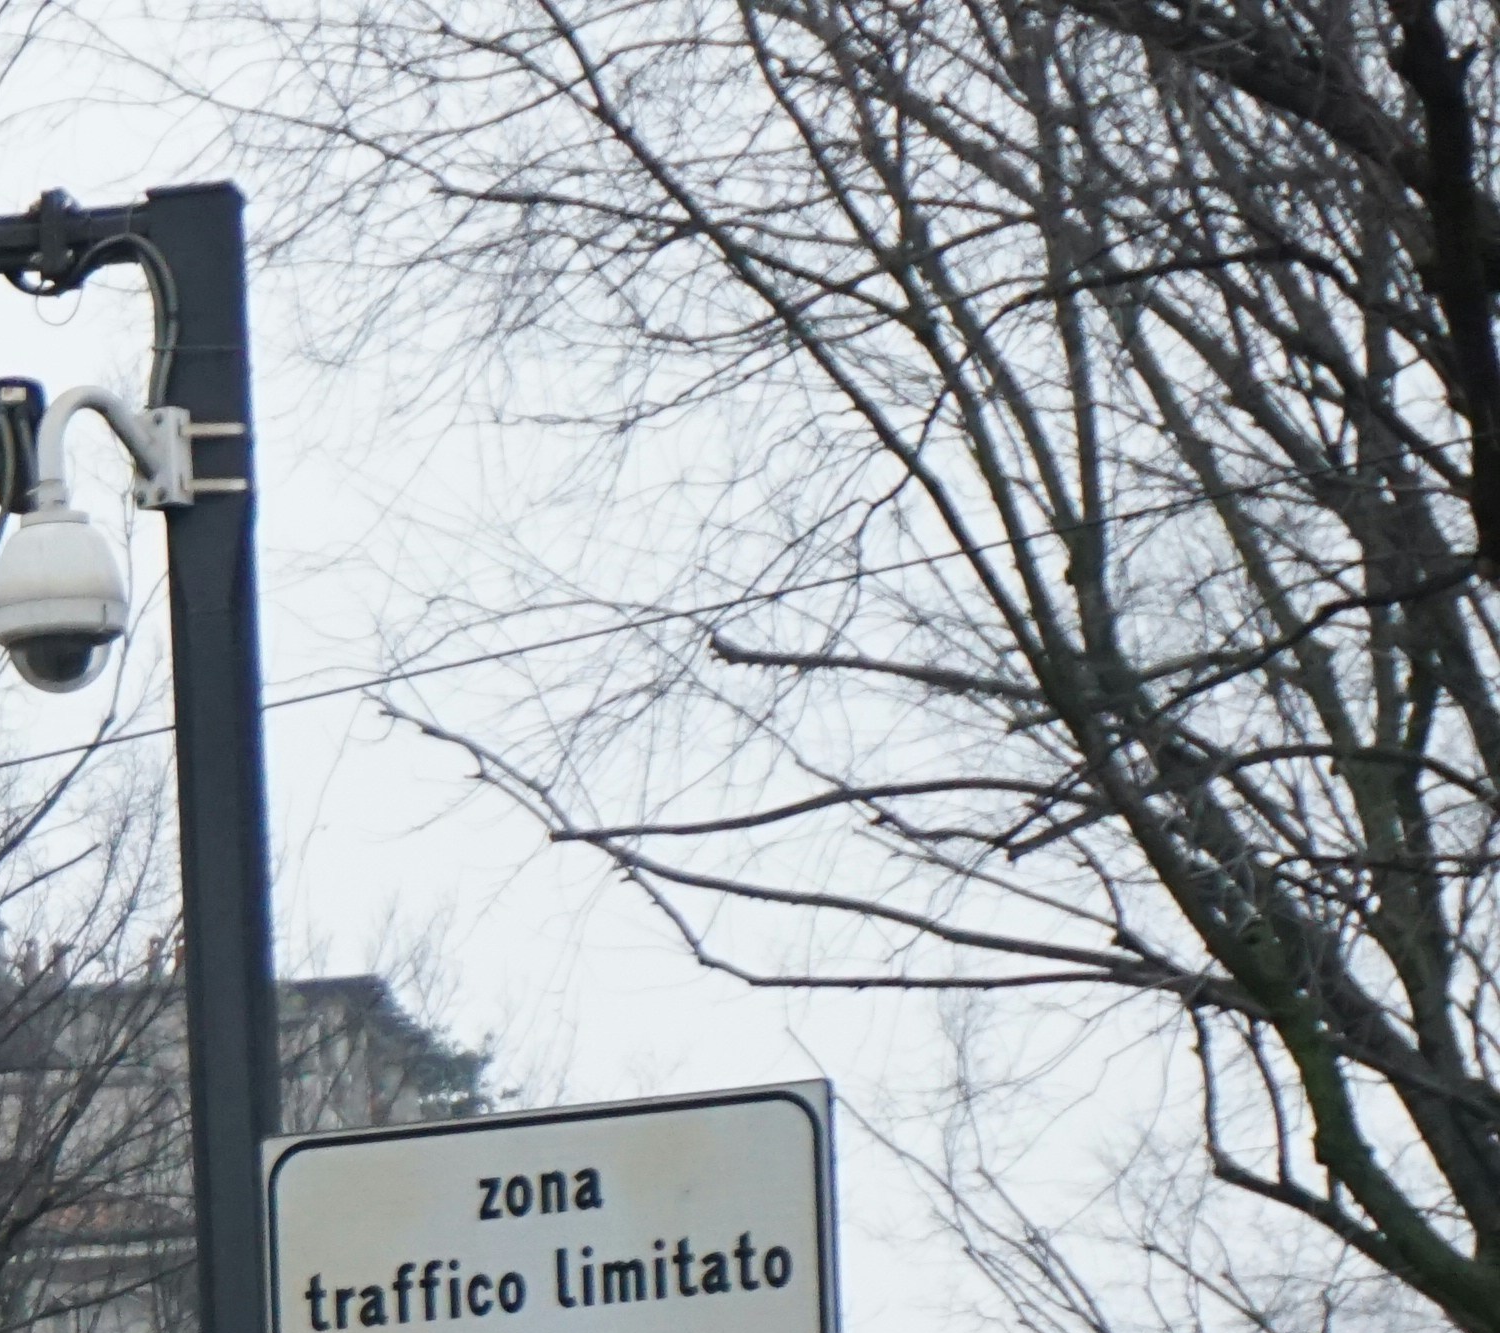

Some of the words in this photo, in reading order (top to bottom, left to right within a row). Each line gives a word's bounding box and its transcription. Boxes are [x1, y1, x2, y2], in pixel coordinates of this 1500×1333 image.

[477, 1164, 604, 1222] zona
[304, 1257, 526, 1333] traffico
[554, 1229, 794, 1310] limitato
